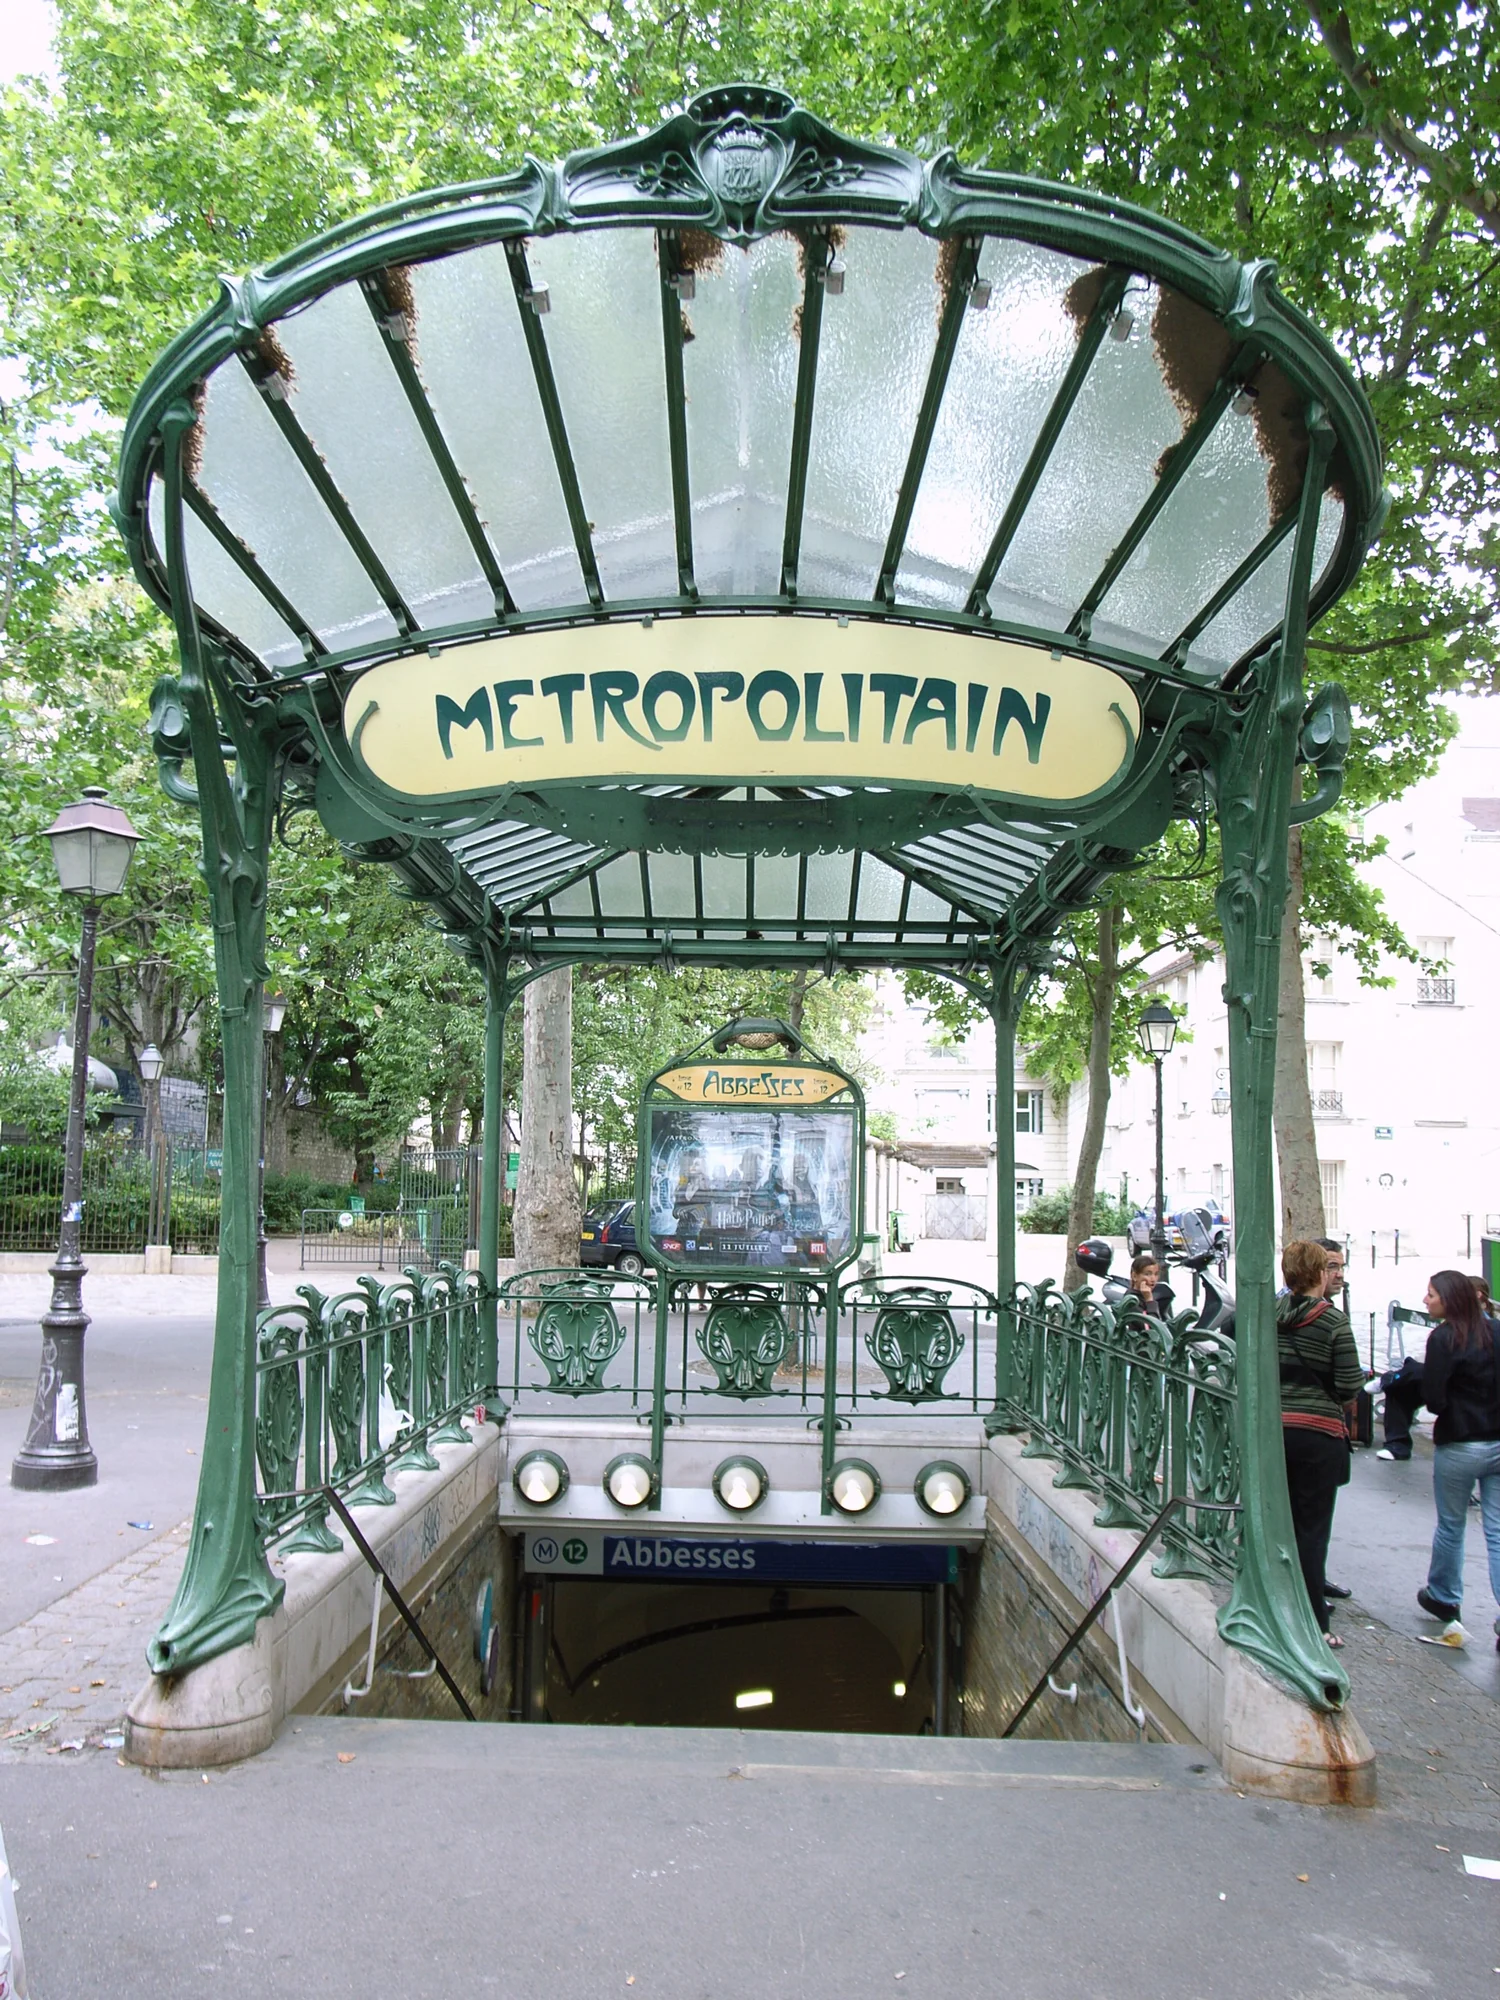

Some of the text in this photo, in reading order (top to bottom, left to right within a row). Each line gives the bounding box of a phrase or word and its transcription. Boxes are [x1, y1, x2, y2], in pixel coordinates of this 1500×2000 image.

[434, 669, 1051, 765] METROPOLITAIN
[684, 1082, 692, 1091] 12
[702, 1070, 805, 1098] ABBESSES
[820, 1085, 828, 1094] 12
[717, 1209, 744, 1230] Harry
[745, 1208, 776, 1232] Potter
[662, 1242, 681, 1250] SNCF
[723, 1243, 732, 1251] 11
[811, 1243, 826, 1253] RTL
[565, 1543, 585, 1560] 12
[610, 1540, 756, 1569] Abbesses
